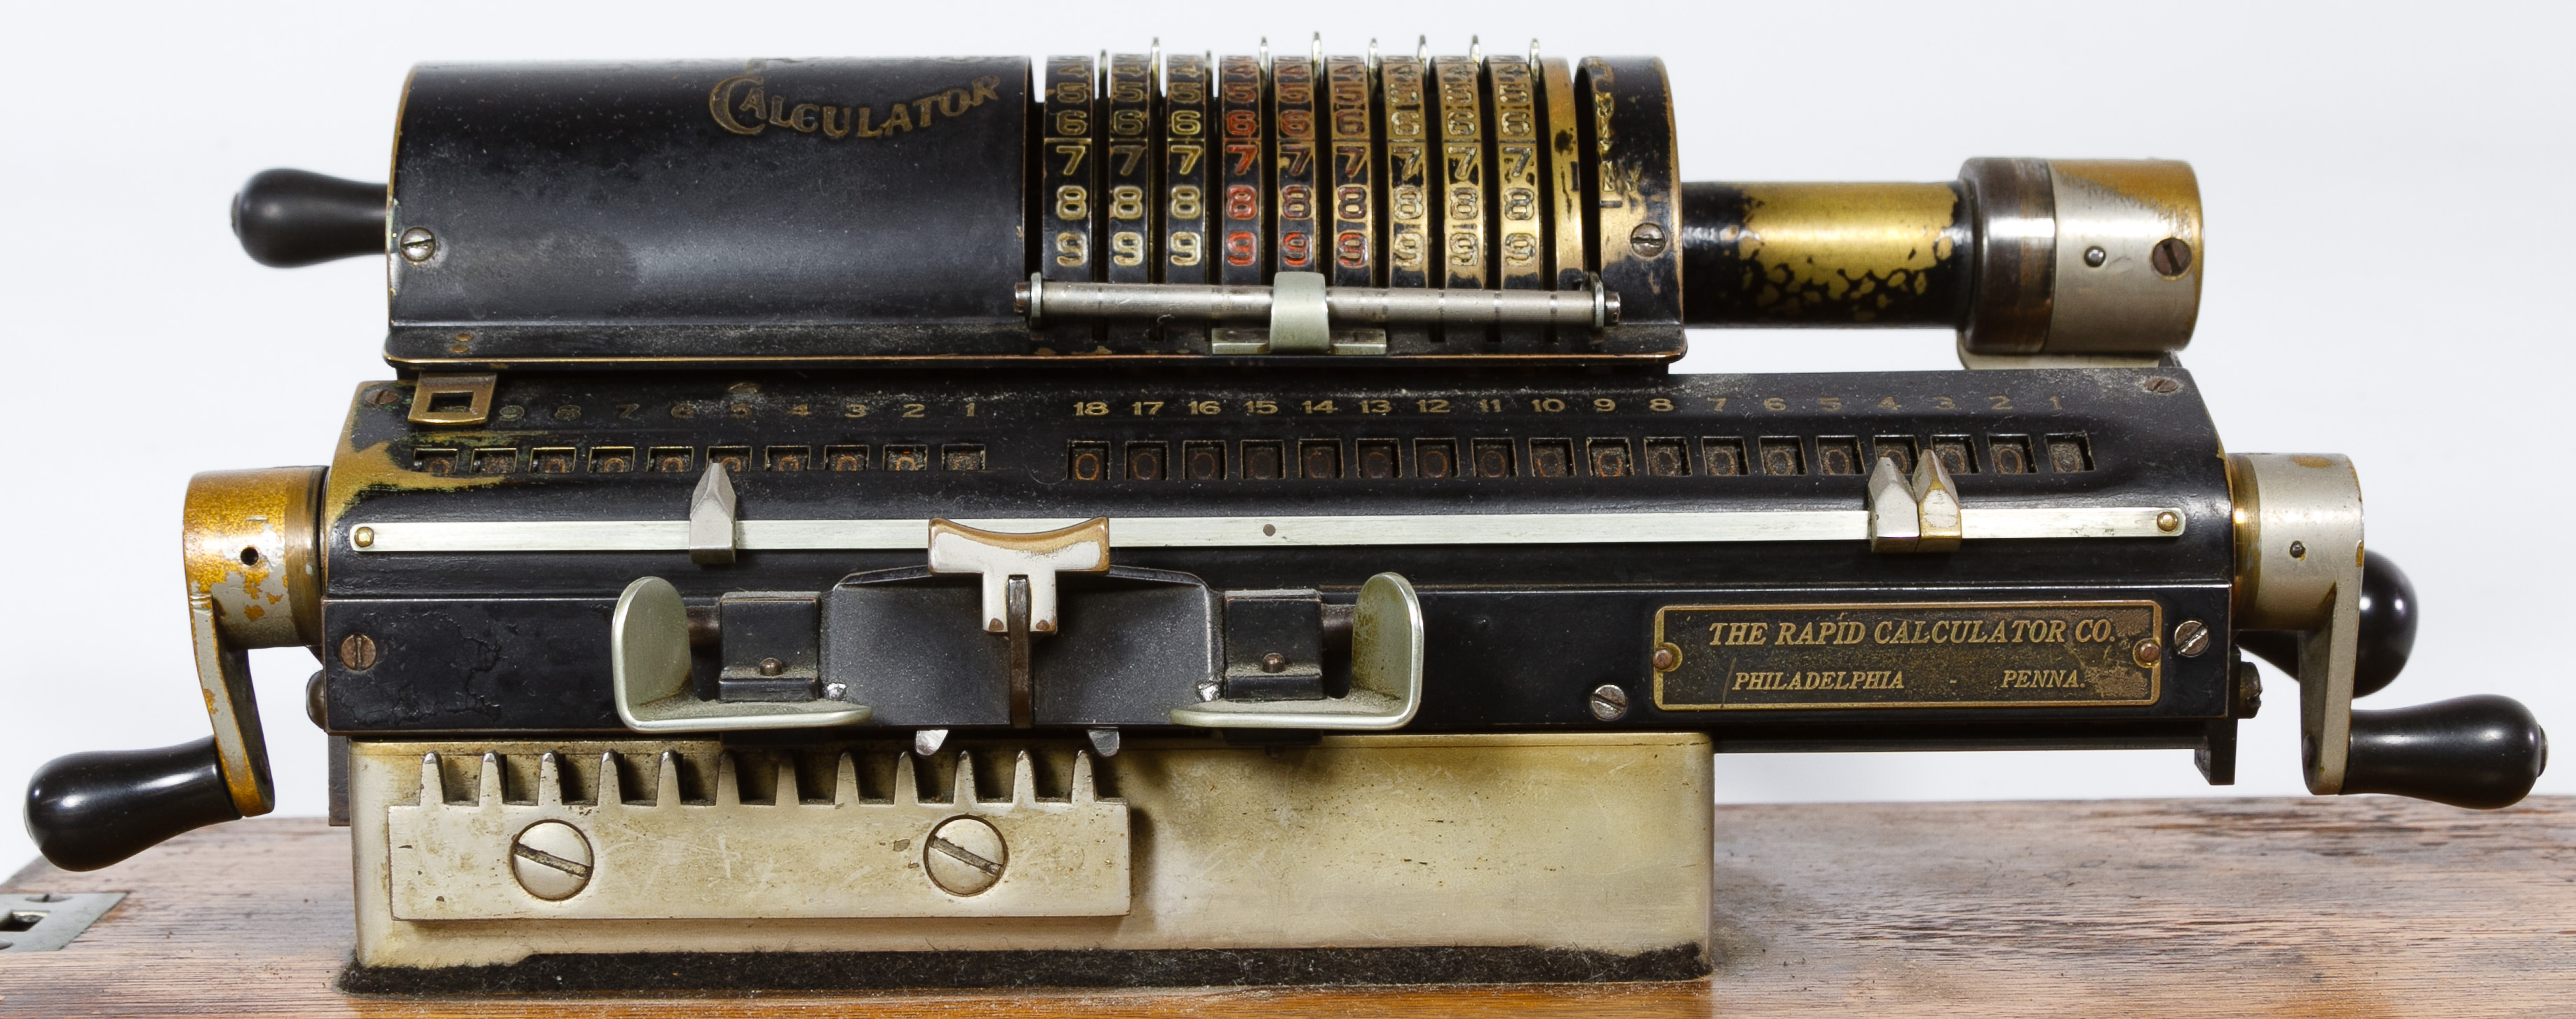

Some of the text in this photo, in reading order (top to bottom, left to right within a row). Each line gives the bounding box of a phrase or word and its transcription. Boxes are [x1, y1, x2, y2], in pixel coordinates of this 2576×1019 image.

[1058, 64, 1088, 77] 4
[1117, 64, 1145, 76] 4
[1172, 63, 1201, 77] 4
[1227, 65, 1256, 78] 4
[1280, 65, 1309, 77] 4
[1334, 65, 1362, 78] 4
[1389, 65, 1417, 78] 4
[709, 74, 1000, 137] CALCULATOR
[1058, 82, 1087, 103] 5
[1114, 82, 1143, 102] 5
[1171, 82, 1201, 104] 5
[1226, 82, 1256, 103] 5
[1280, 82, 1309, 103] 5
[1334, 82, 1364, 104] 5
[1445, 83, 1472, 103] 5
[1499, 83, 1528, 103] 5
[1057, 109, 1530, 136] 6 6 6 6 6 6 6 6 6
[1056, 144, 1532, 177] 7 7 7 7 7 7 7 7 7
[1057, 184, 1535, 220] 8 8 8 8 8 8 8 8 8
[1056, 231, 1535, 267] 9 9 9 9 9 9 9 9 9
[499, 403, 976, 421] 9 8 7 6 5 4 3 2 1
[1073, 396, 2063, 416] 18 17 16 15 14 13 12 11 10 9 8 7 6 5 4 3 2 1
[1076, 453, 1099, 480] 0
[1133, 452, 1156, 480] 0
[1192, 452, 1215, 480] 0
[1249, 452, 1274, 480] 0
[1307, 451, 1330, 479] 0
[1365, 451, 1389, 479] 0
[1423, 451, 1448, 478] 0
[1481, 451, 1506, 478] 0
[1537, 451, 1562, 477] 0
[1598, 451, 1622, 476] 0
[1711, 451, 1734, 475] 0
[1767, 450, 1793, 475] 0
[1825, 450, 1850, 475] 0
[1997, 447, 2022, 474] 0
[1709, 619, 2117, 645] THE RAPID CALCULATOR CO.
[1732, 671, 1906, 690] PHILADELPHIA
[2000, 670, 2086, 689] PENNA.
